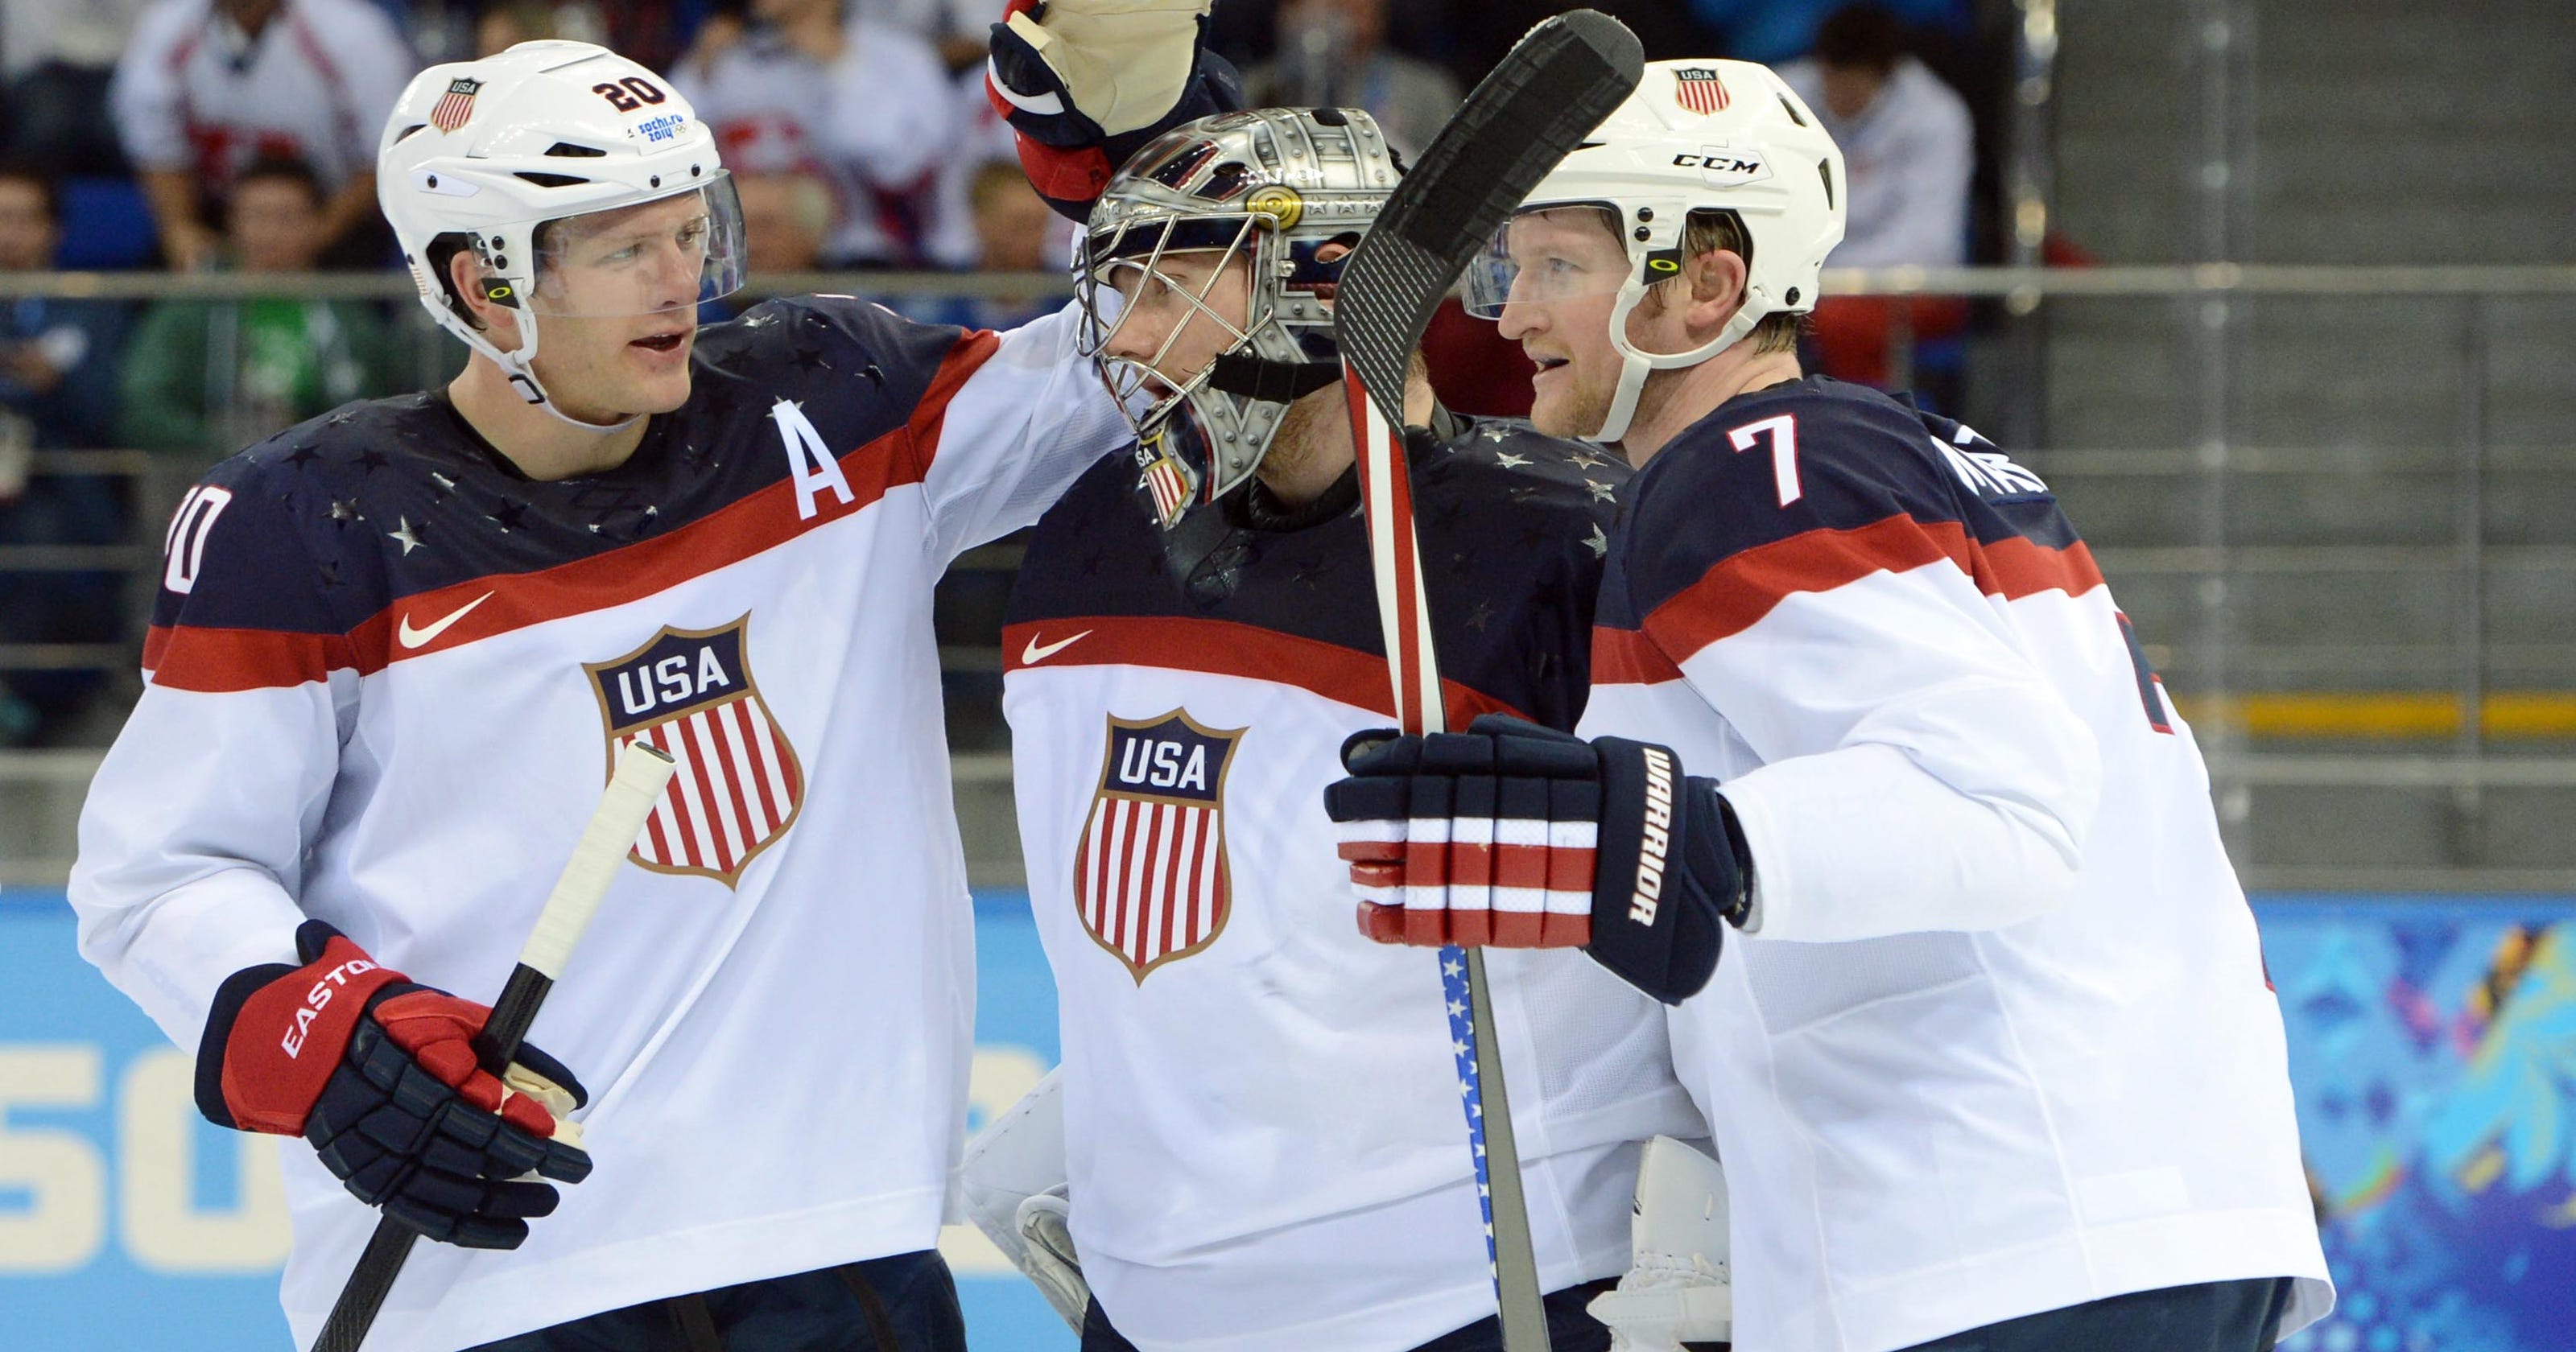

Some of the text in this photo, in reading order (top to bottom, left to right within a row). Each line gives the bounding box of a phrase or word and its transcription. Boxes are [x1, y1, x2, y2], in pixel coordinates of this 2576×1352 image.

[451, 81, 476, 93] USA
[592, 76, 667, 113] 20
[1680, 70, 1714, 80] USA
[1673, 154, 1761, 174] CCM
[771, 398, 857, 521] A
[1135, 447, 1155, 468] SA
[1726, 411, 1804, 509] 7
[617, 645, 730, 715] USA
[1119, 737, 1206, 791] USA
[1628, 747, 1673, 927] WARRIOR
